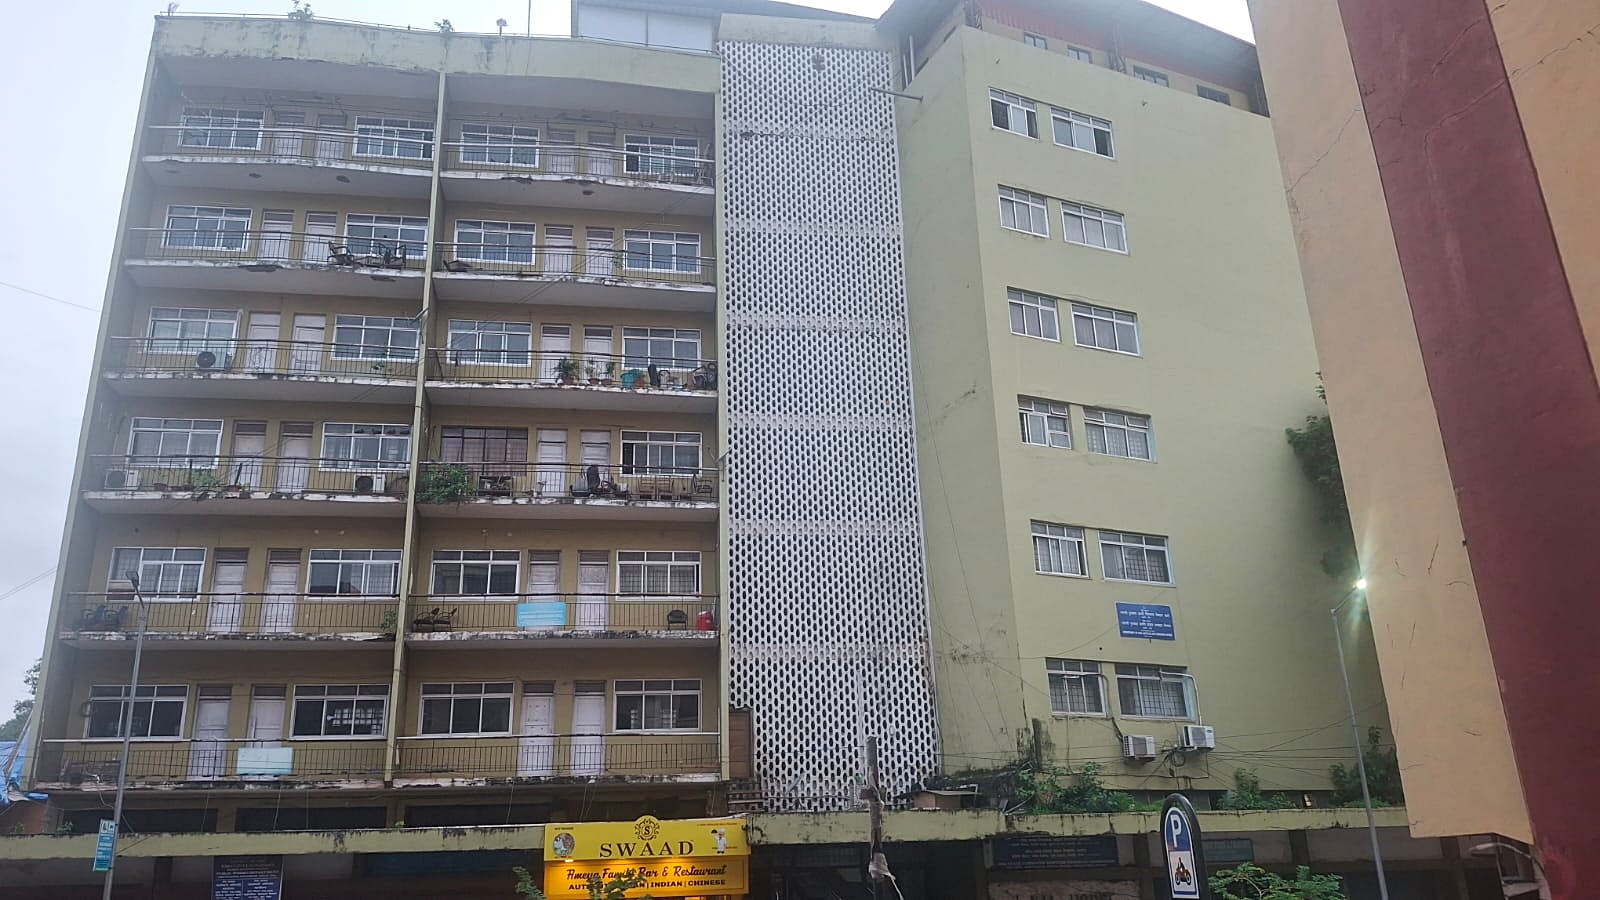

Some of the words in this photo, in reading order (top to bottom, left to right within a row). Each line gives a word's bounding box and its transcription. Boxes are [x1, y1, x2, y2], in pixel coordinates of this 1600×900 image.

[643, 826, 650, 835] S
[1170, 814, 1182, 848] P
[599, 841, 693, 858] SWAAD
[638, 867, 659, 877] Bar
[661, 867, 669, 876] &
[673, 864, 727, 876] Restaurant
[688, 879, 726, 887] CHINESE
